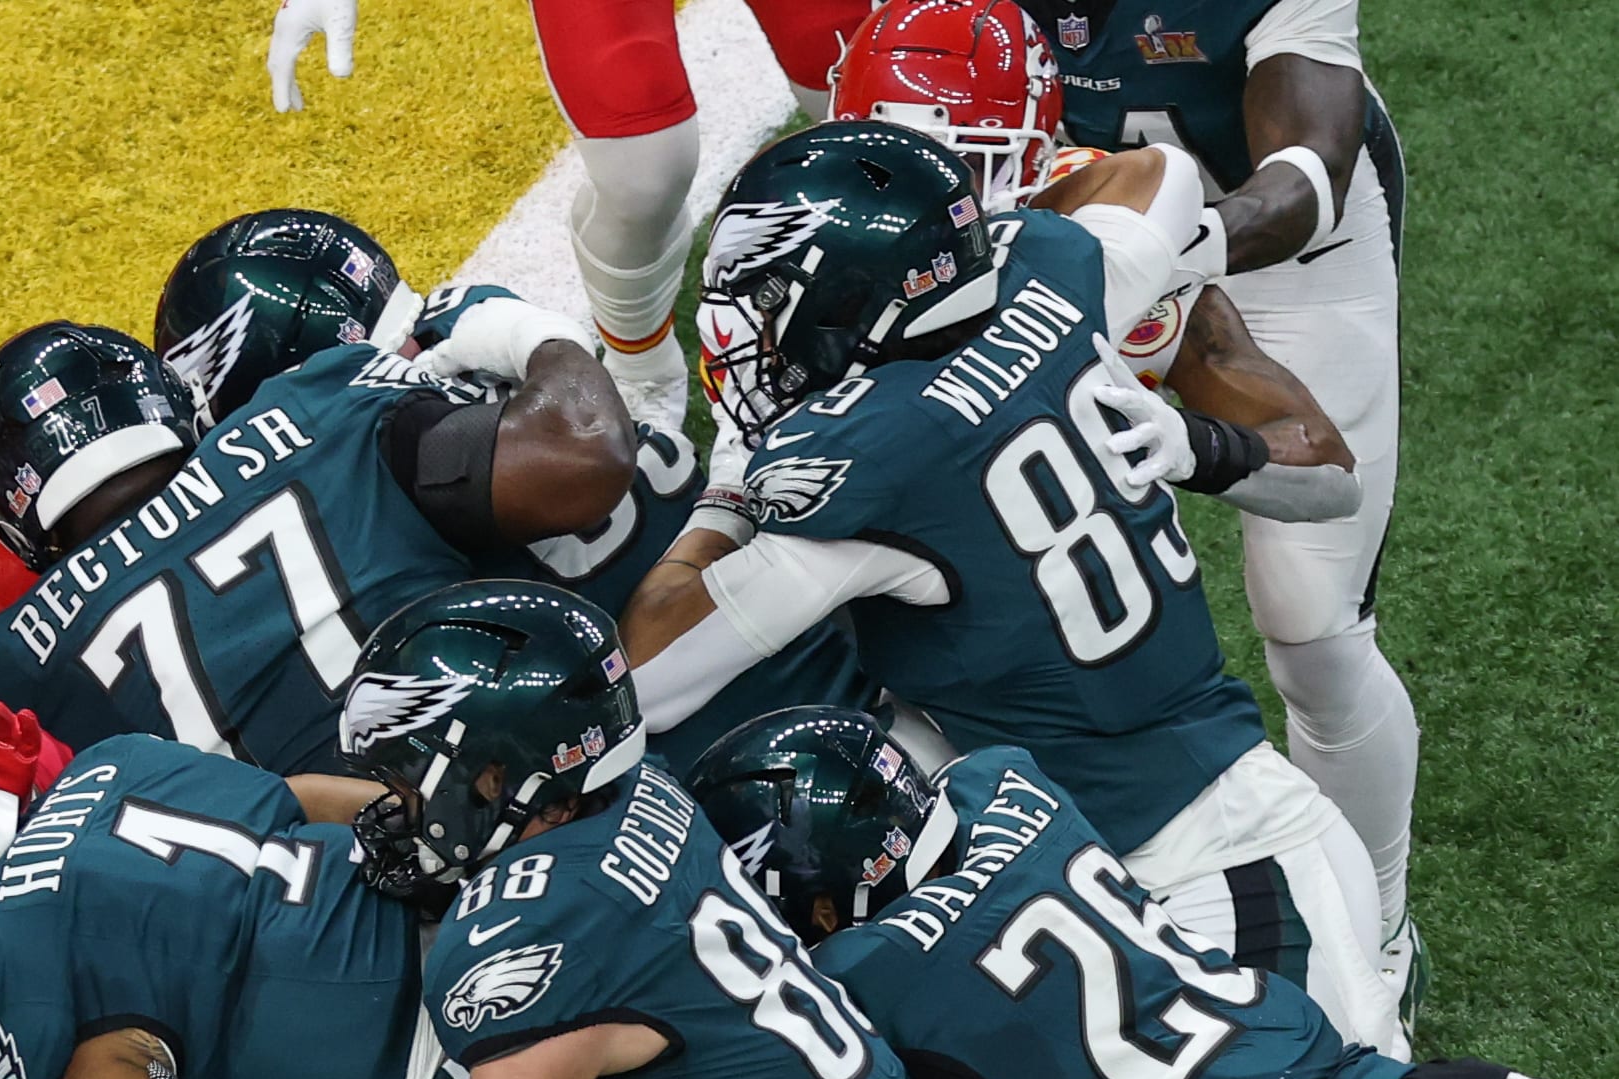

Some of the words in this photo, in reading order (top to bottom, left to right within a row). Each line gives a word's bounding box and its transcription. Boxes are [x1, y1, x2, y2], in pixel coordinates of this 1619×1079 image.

[921, 278, 1084, 425] WILSON
[12, 457, 224, 665] BECTON
[218, 407, 313, 481] SR
[81, 488, 364, 760] 77
[112, 795, 322, 905] 1
[455, 854, 556, 919] 88
[600, 763, 695, 906] GOEDER
